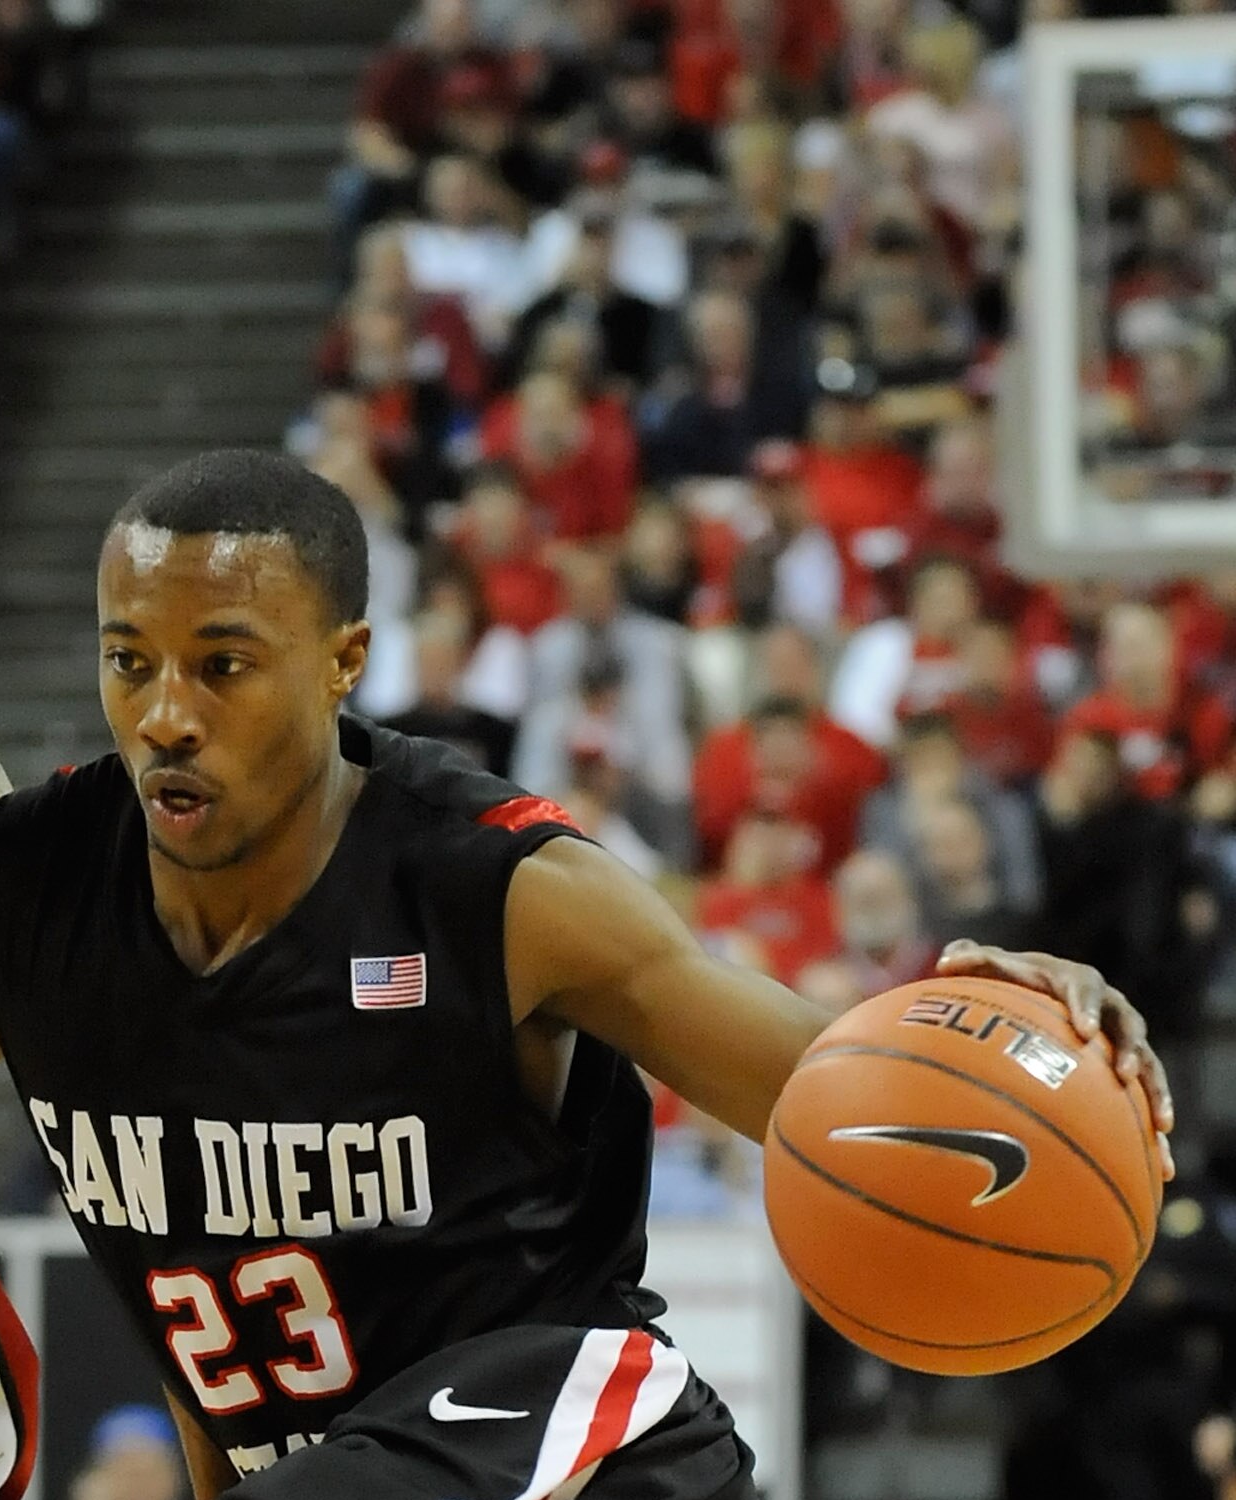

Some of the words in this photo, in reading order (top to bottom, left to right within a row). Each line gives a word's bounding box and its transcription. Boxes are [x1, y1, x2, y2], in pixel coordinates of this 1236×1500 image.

[29, 1097, 169, 1236] SAN
[194, 1114, 434, 1238] DIEGO
[145, 1243, 361, 1417] 23
